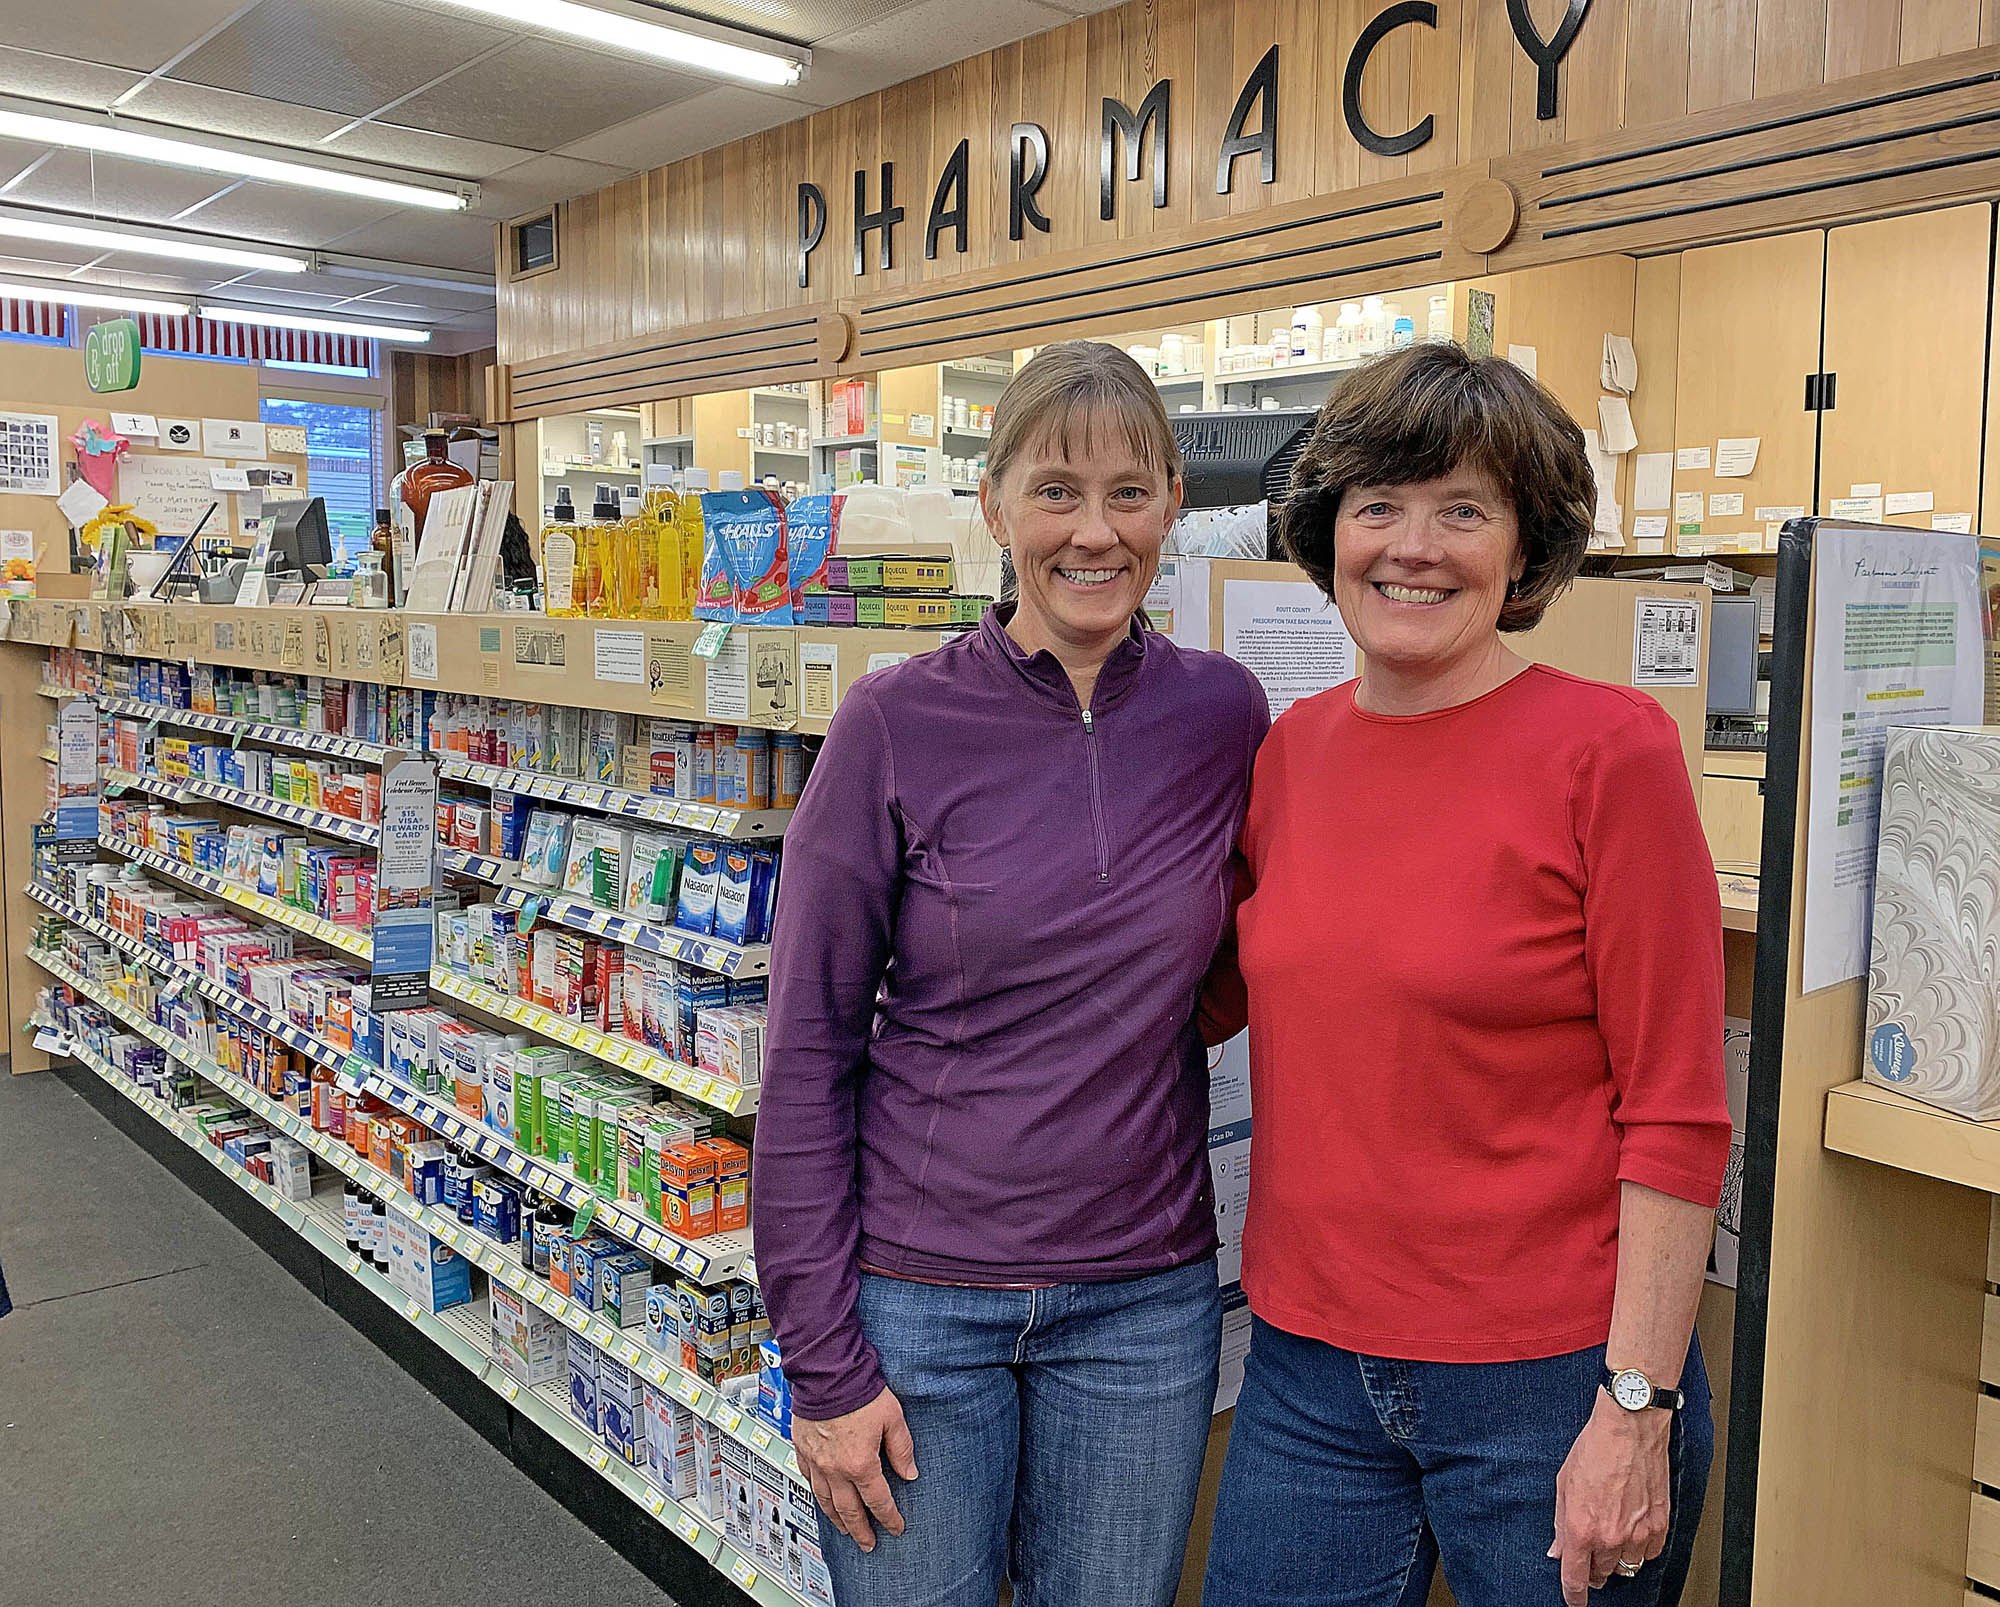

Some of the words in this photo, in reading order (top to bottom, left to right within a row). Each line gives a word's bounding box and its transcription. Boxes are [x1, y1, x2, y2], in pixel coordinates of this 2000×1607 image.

[799, 0, 1590, 288] PHARMACY
[102, 327, 125, 361] drop
[106, 353, 119, 385] off
[719, 522, 780, 540] HALLS
[788, 525, 828, 542] HALLS
[1252, 617, 1285, 625] PRESCRIPTION
[401, 810, 416, 818] $15
[683, 877, 714, 896] Nasacort
[720, 886, 746, 904] Nasacort
[691, 975, 725, 985] Mucinex
[1890, 1032, 1905, 1081] Kleenex
[1212, 1133, 1225, 1142] Can
[660, 1157, 685, 1178] Delsym
[687, 1164, 713, 1176] Delsym
[722, 1158, 746, 1169] Delsym
[478, 1198, 497, 1217] NyQuil
[670, 1201, 679, 1214] 12
[713, 1318, 726, 1326] Cold
[735, 1310, 748, 1318] Cold
[788, 1479, 813, 1503] Neil
[791, 1496, 813, 1518] SINUS
